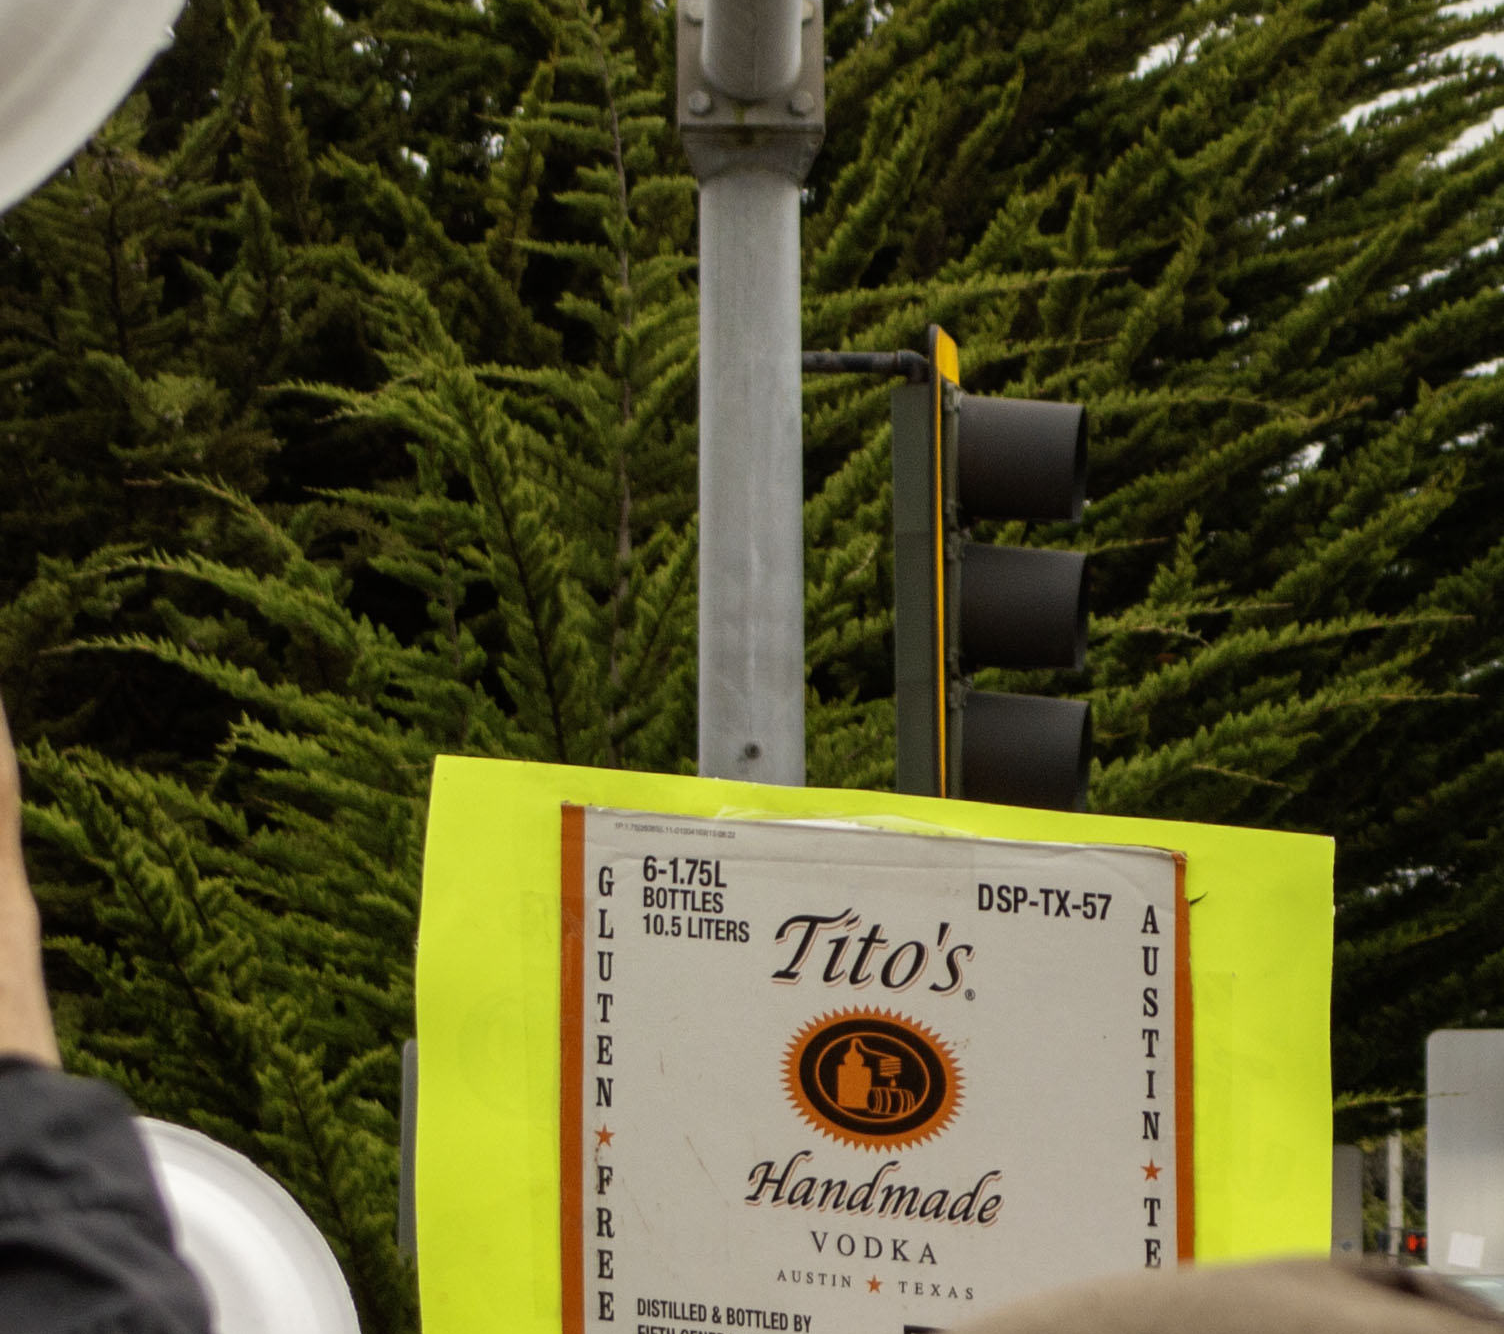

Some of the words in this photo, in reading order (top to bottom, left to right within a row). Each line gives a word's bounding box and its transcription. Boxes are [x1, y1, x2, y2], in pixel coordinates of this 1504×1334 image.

[642, 855, 728, 889] 6-1.75L
[642, 886, 725, 915] BOTTLES
[977, 883, 1113, 921] DSP-TX-57
[642, 913, 683, 938] 10.5
[687, 917, 751, 944] LITERS
[596, 866, 615, 1108] GLUTEN
[1141, 905, 1161, 1141] AUSTIN
[744, 1149, 1005, 1229] Handmade
[596, 1165, 615, 1322] FREE
[810, 1229, 939, 1266] VODKA
[777, 1268, 853, 1289] AUSTIN
[898, 1280, 975, 1301] TEXAS
[637, 1298, 707, 1322] DISTILLED
[712, 1305, 723, 1324] &
[726, 1307, 789, 1332] BOTTLED
[793, 1314, 812, 1334] BY
